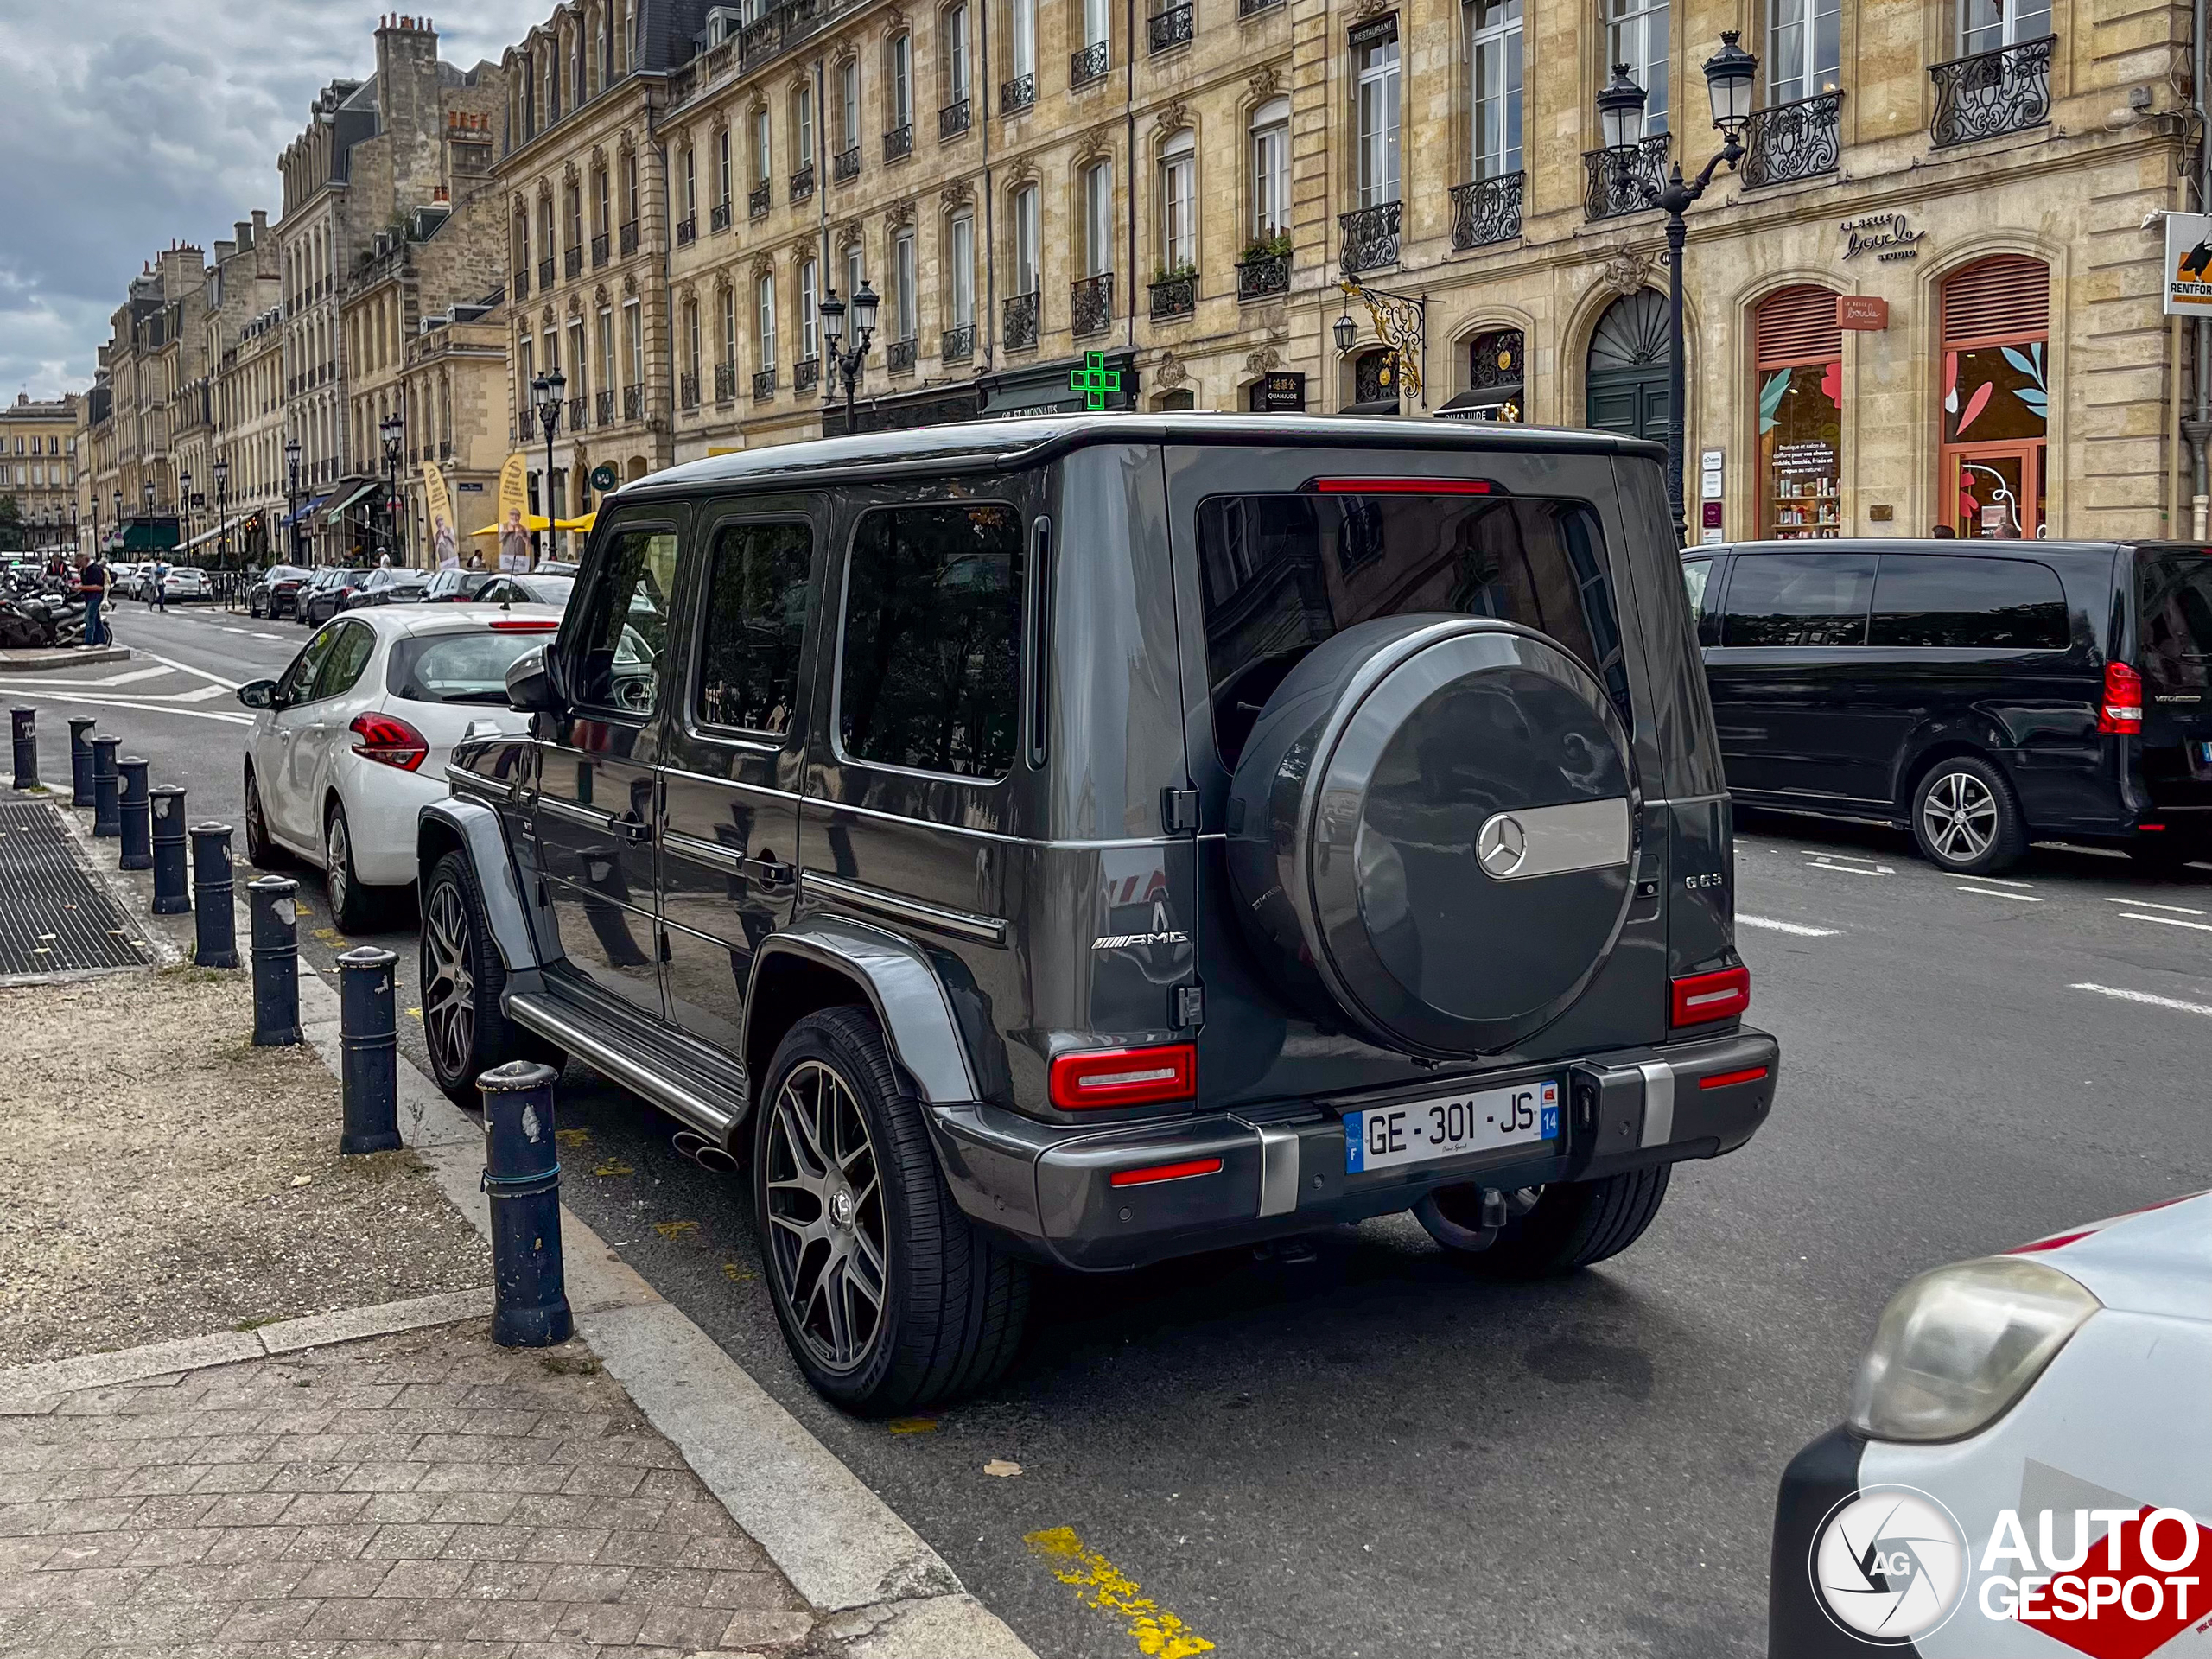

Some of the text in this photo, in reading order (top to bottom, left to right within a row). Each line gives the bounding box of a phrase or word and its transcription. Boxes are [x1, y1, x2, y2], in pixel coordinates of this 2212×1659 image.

[1354, 21, 1391, 41] RESTAURANT
[1841, 214, 1926, 260] boucle
[1878, 250, 1916, 261] STUDIO
[1846, 303, 1881, 320] boucle
[1124, 931, 1189, 948] AMG
[1543, 1111, 1557, 1129] 14
[1351, 1148, 1357, 1160] F
